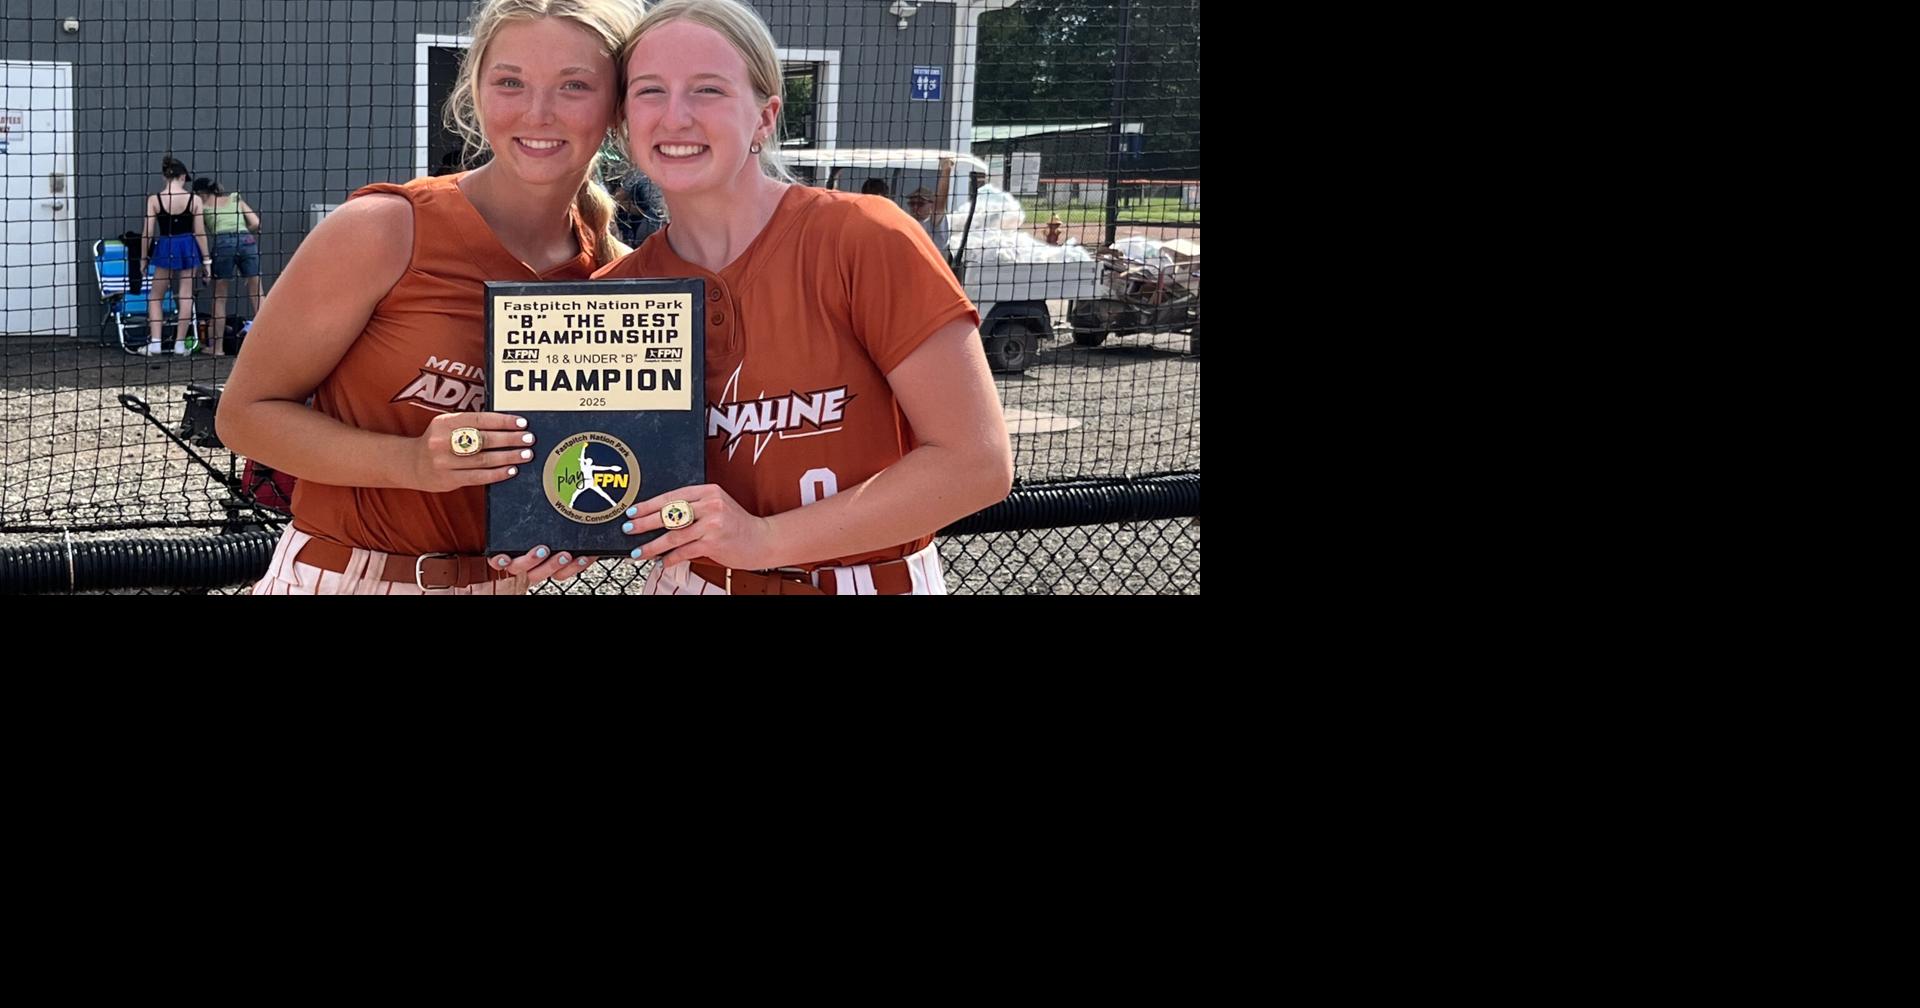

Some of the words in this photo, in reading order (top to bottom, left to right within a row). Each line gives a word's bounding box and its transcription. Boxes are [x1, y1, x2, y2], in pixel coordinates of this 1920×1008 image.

[504, 301, 581, 312] Fastpitch
[587, 300, 640, 310] Nation
[645, 300, 683, 309] Park
[563, 314, 605, 328] THE
[622, 313, 679, 327] BEST
[507, 330, 679, 344] CHAMPIONSHIP
[514, 350, 538, 359] FPN
[546, 355, 558, 364] 18
[562, 355, 570, 363] &
[574, 354, 618, 364] UNDER
[657, 349, 681, 358] FPN
[504, 369, 682, 391] CHAMPION
[579, 398, 607, 407] 2025
[555, 434, 588, 455] Fastpitch
[589, 434, 615, 446] Nation
[615, 441, 629, 457] Park
[557, 467, 590, 492] play
[593, 473, 629, 488] FPN
[585, 503, 627, 522] Connecticut
